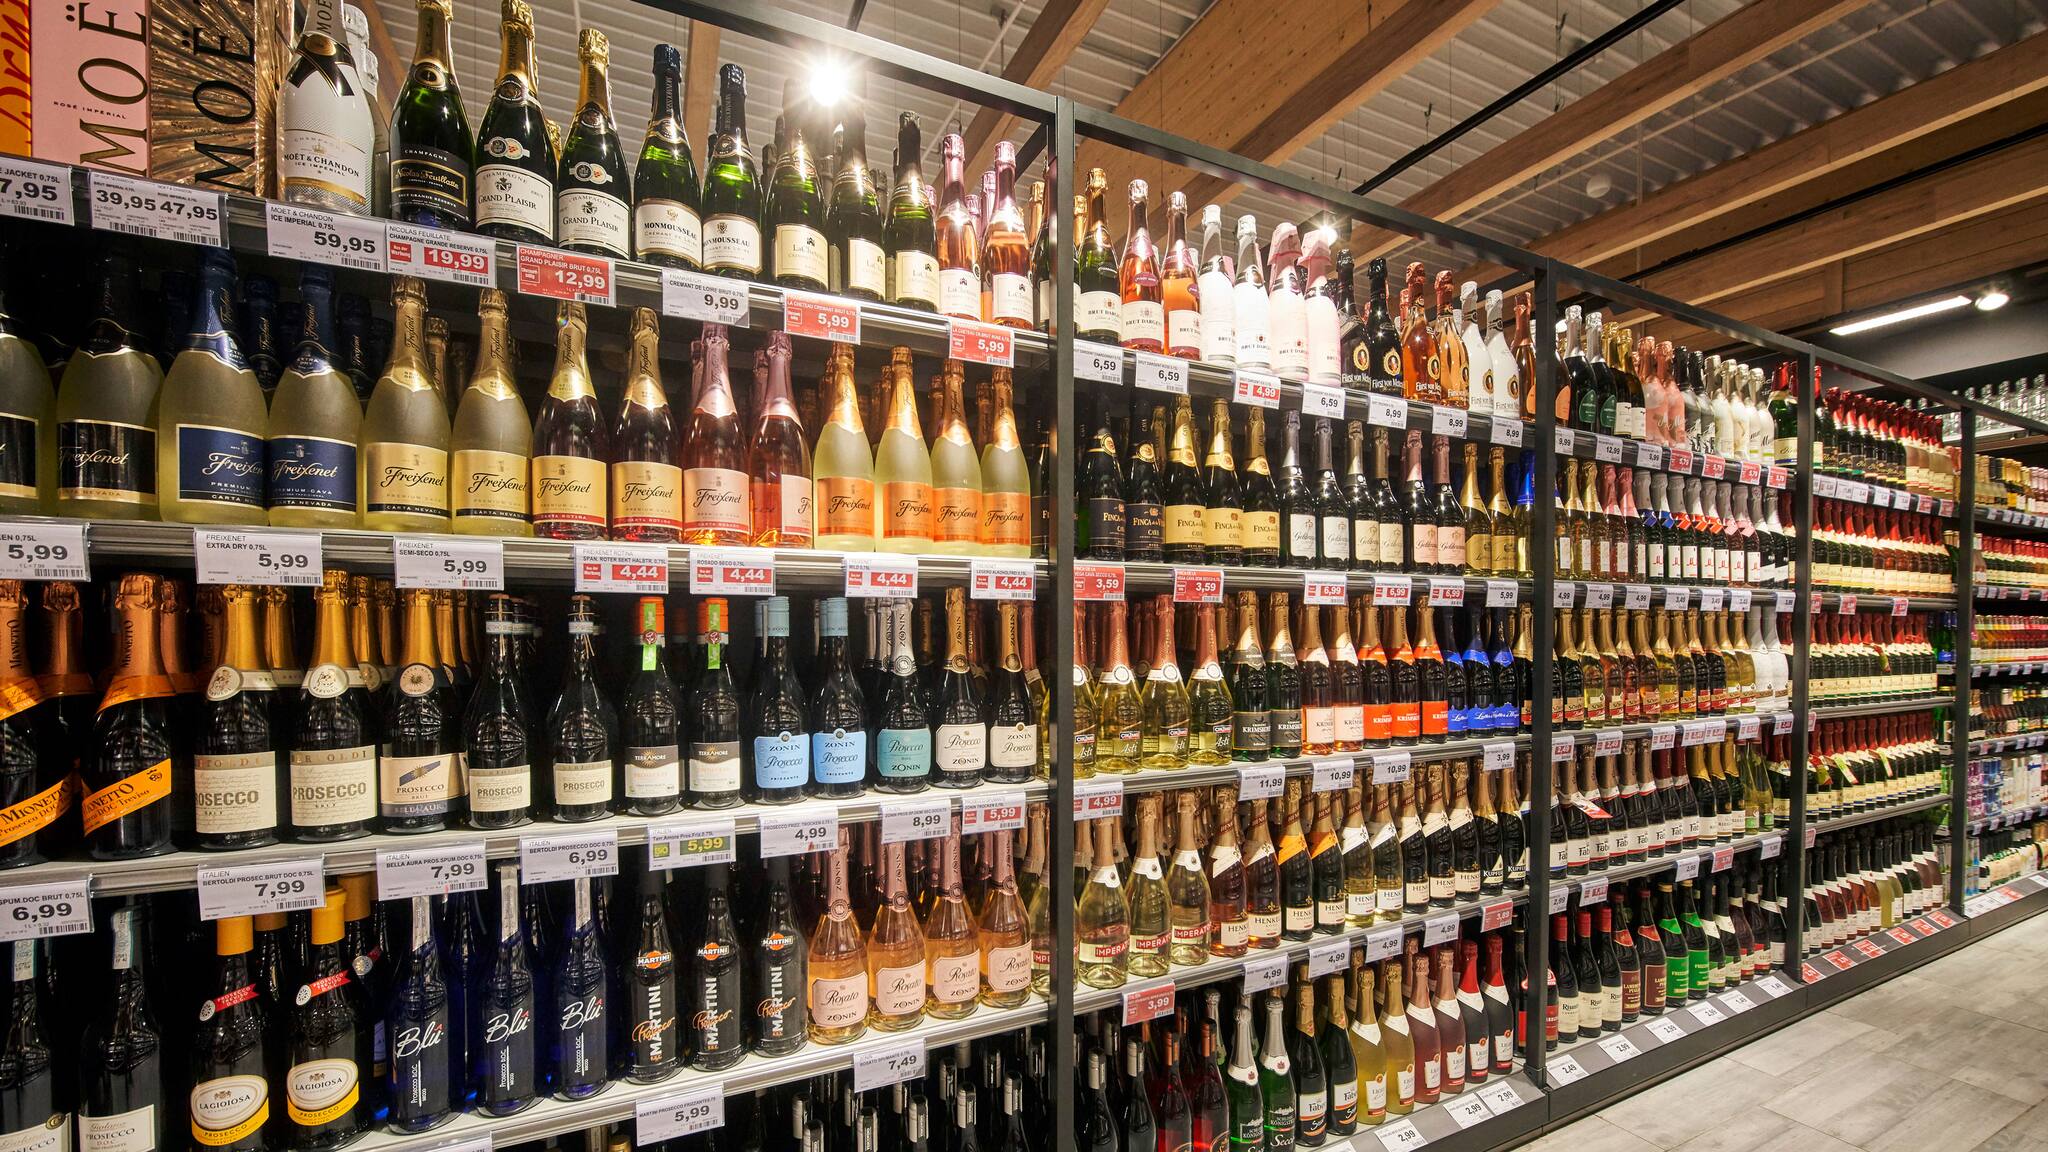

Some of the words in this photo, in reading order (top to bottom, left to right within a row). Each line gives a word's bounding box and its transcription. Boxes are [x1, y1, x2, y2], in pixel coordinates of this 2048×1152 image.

[65, 0, 148, 178] MOË
[181, 0, 256, 196] MOË
[404, 149, 448, 162] CHAMPAGNE
[314, 157, 359, 177] CHANDON
[4, 168, 37, 180] JACKET
[96, 189, 156, 211] 39,95
[478, 194, 502, 203] GRAND
[504, 194, 537, 210] PLAISIR
[160, 201, 218, 221] 47,95
[299, 210, 334, 223] CHANDON
[285, 217, 317, 229] IMPERIAL
[562, 216, 588, 225] GRAND
[590, 216, 619, 233] PLAISIR
[390, 226, 418, 236] NICOLAS
[314, 231, 376, 253] 59,95
[390, 233, 424, 244] CHAMPAGNE
[428, 249, 485, 269] 19,99
[520, 248, 564, 260] CHAMPAGNER
[520, 256, 543, 265] GRAND
[544, 259, 568, 269] PLAISIR
[569, 264, 585, 272] BRUT
[555, 270, 606, 289] 12,99
[704, 294, 739, 310] 9,99
[817, 313, 849, 328] 5,99
[978, 339, 1004, 353] 5,99
[1093, 358, 1116, 371] 6,59
[1158, 370, 1180, 381] 6,59
[1256, 386, 1276, 398] 4,99
[1320, 397, 1338, 408] 6,59
[1385, 409, 1401, 418] 8,99
[1449, 418, 1464, 428] 8,99
[1506, 429, 1519, 438] 8,99
[1558, 438, 1571, 446] 9,99
[271, 459, 338, 481] Freixenet
[380, 466, 445, 488] Freixenet
[467, 472, 528, 493] Freixenet
[537, 477, 592, 499] Freixenet
[622, 482, 673, 502] Freixenet
[692, 488, 742, 508] Freixenet
[828, 495, 871, 514] Freixenet
[937, 505, 978, 525] Freixenet
[985, 509, 1024, 527] Freixenet
[206, 534, 246, 542] FREIXENET
[206, 542, 229, 550] EXTRA
[8, 544, 68, 563] 5,99
[258, 553, 309, 571] 5,99
[444, 560, 487, 576] 5,99
[620, 565, 658, 580] 4,44
[730, 568, 765, 582] 4,44
[877, 573, 907, 586] 4,44
[1001, 577, 1027, 589] 4,44
[1096, 579, 1119, 590] 3,59
[1196, 582, 1216, 592] 3,59
[1323, 585, 1341, 595] 6,99
[1389, 588, 1405, 597] 6,99
[1445, 588, 1460, 597] 6,99
[1500, 591, 1513, 600] 5,99
[1558, 591, 1570, 600] 4,99
[1598, 593, 1610, 601] 4,99
[1636, 594, 1647, 602] 4,99
[9, 619, 20, 670] MIONETTO
[947, 735, 981, 749] Prosecco
[1007, 732, 1032, 740] ZONIN
[769, 743, 801, 751] ZONIN
[824, 741, 855, 749] ZONIN
[888, 740, 924, 754] Prosecco
[1001, 741, 1033, 754] Prosecco
[764, 756, 803, 769] Prosecco
[820, 752, 858, 765] Prosecco
[952, 757, 979, 765] ZONIN
[1496, 753, 1510, 762] 3,99
[891, 763, 921, 772] ZONIN
[1387, 765, 1406, 774] 10,99
[1330, 770, 1351, 780] 10,99
[396, 784, 444, 793] PROSECCO
[563, 780, 605, 791] PROSECCO
[1259, 778, 1283, 788] 11,99
[293, 783, 367, 802] PROSECCO
[477, 785, 522, 797] PROSECCO
[1, 788, 65, 825] MIONETT
[1093, 795, 1117, 806] 4,99
[990, 807, 1016, 820] 5,99
[913, 814, 941, 828] 8,99
[795, 827, 827, 841] 4,99
[529, 846, 557, 854] BERTOLDI
[687, 837, 724, 853] 5,99
[569, 849, 608, 865] 6,99
[202, 870, 230, 879] ITALIEN
[431, 863, 475, 880] 7,99
[203, 877, 236, 886] BERTOLDI
[283, 872, 297, 880] DOC
[254, 880, 305, 898] 7,99
[42, 894, 63, 902] BRUT
[64, 892, 84, 900] 0,75L
[12, 902, 72, 922] 6,99
[1441, 924, 1455, 933] 4,99
[762, 936, 793, 946] MARTINI
[1382, 940, 1398, 949] 4,99
[698, 945, 729, 957] MARTINI
[637, 953, 669, 966] MARTINI
[1329, 953, 1345, 963] 4,99
[945, 967, 978, 984] Rosato
[1263, 968, 1281, 979] 4,99
[888, 977, 922, 994] Rosato
[1005, 976, 1029, 987] ZONIN
[950, 986, 976, 997] ZONIN
[770, 966, 784, 1034] MARTINI
[824, 990, 859, 1008] Rosato
[893, 998, 920, 1009] ZONIN
[1148, 997, 1169, 1010] 3,99
[705, 977, 719, 1046] MARTINI
[826, 1011, 857, 1022] ZONIN
[648, 985, 662, 1057] MARTINI
[1616, 1043, 1631, 1052] 2,99
[888, 1055, 917, 1071] 7,49
[1562, 1063, 1577, 1074] 2,49
[1498, 1090, 1514, 1102] 2,99
[300, 1105, 340, 1118] PROSECCO
[675, 1105, 710, 1123] 5,99
[1465, 1103, 1482, 1115] 2,99
[86, 1128, 136, 1141] PROSECCO
[204, 1123, 248, 1137] PROSECCO
[1398, 1130, 1416, 1142] 2,99
